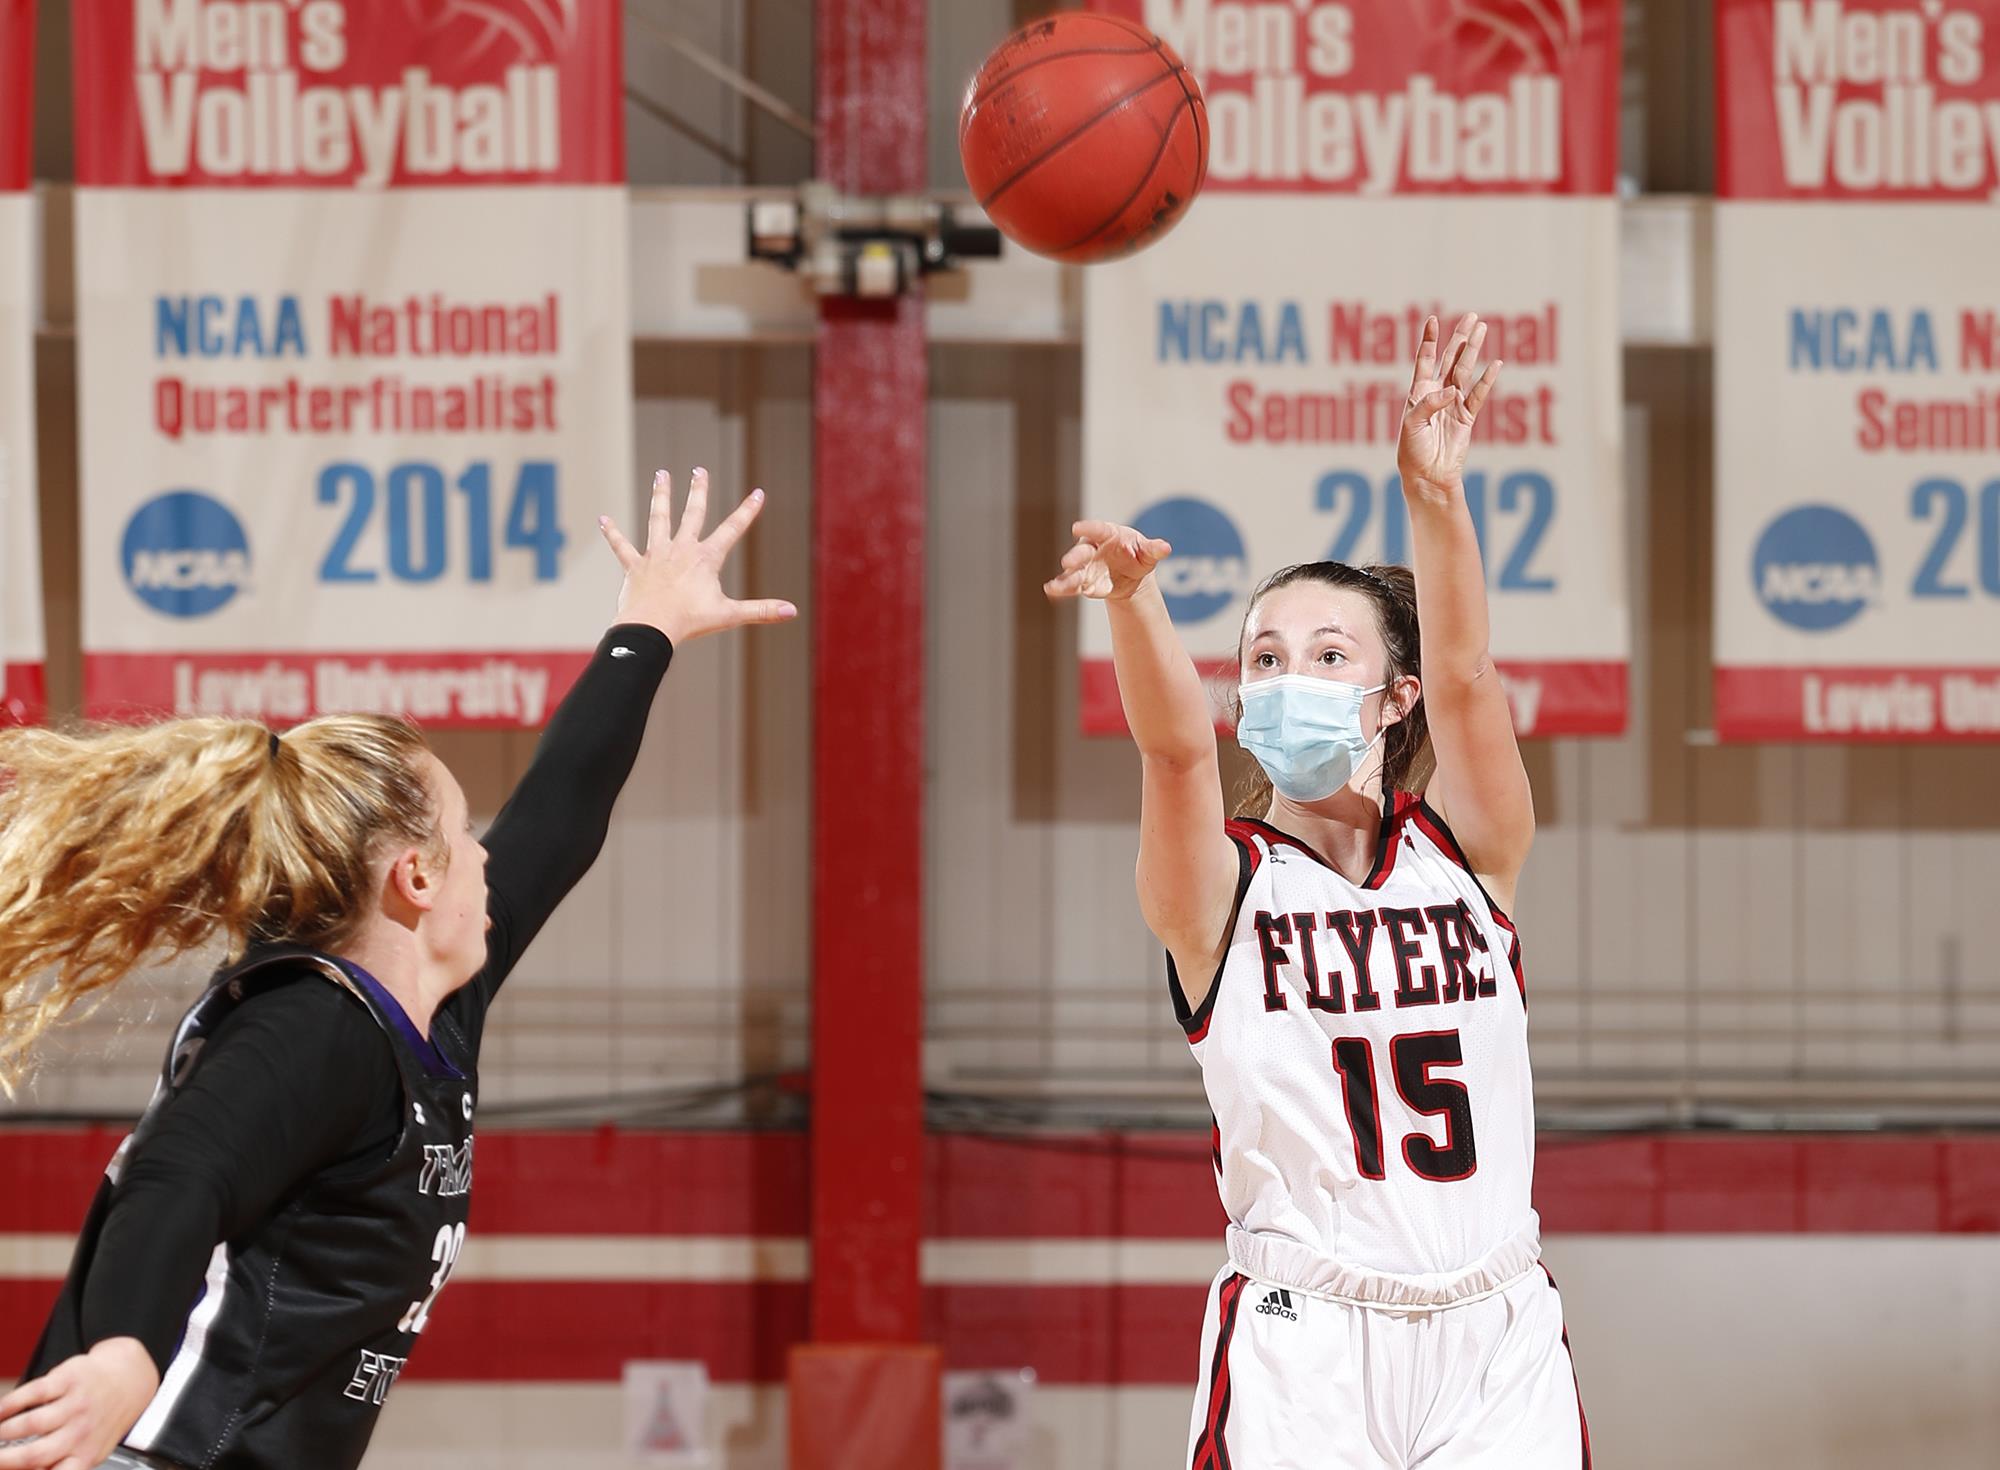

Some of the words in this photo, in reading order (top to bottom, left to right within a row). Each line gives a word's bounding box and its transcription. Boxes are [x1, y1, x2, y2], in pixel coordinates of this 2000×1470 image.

[134, 0, 348, 72] Men's
[1773, 0, 1984, 85] Men's
[135, 67, 560, 190] Volleyball
[1204, 74, 1562, 193] olleyball
[154, 295, 307, 359] NCAA
[328, 293, 560, 356] National
[1158, 301, 1307, 365] NCAA
[1790, 309, 1938, 373] NCAA
[153, 377, 560, 438] Quarterfinalist
[316, 461, 565, 585] 2014
[1332, 1029, 1477, 1183] 15
[1255, 1302, 1298, 1322] adidas
